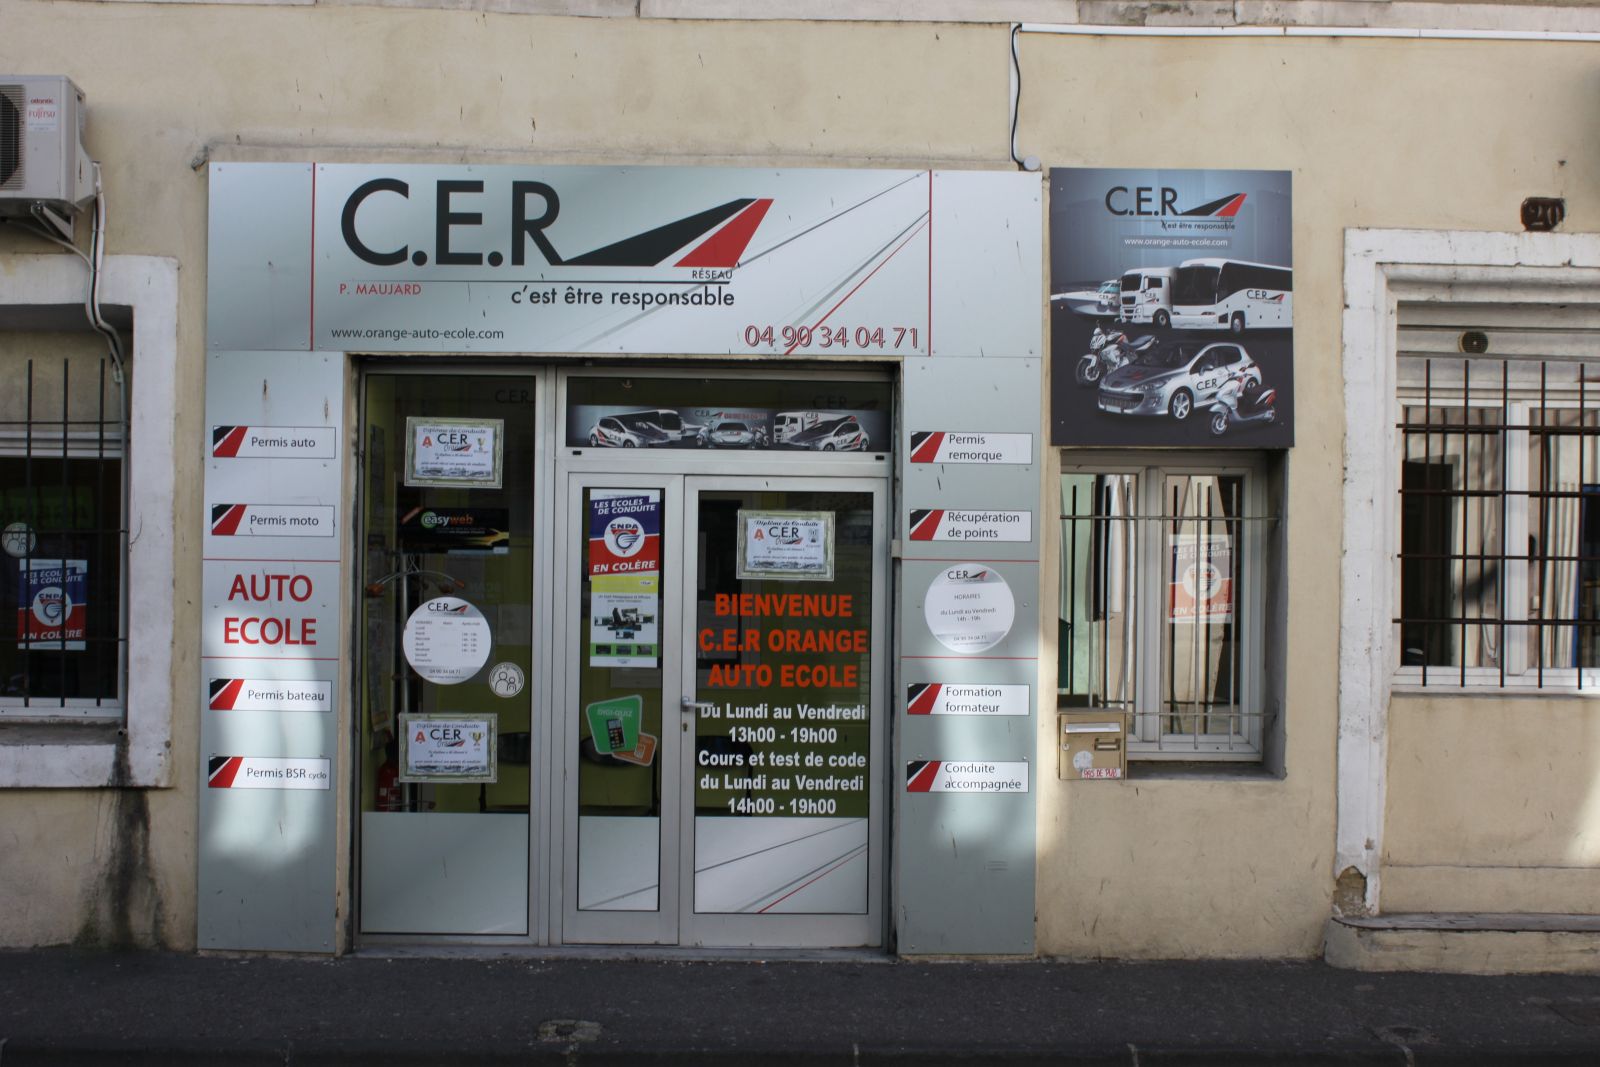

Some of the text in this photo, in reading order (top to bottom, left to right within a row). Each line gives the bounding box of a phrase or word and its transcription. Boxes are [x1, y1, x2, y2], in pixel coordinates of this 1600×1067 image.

[1105, 186, 1178, 216] C.E.R
[341, 177, 565, 266] C.E.R
[1124, 237, 1228, 247] www.orange-auto-ecole.com
[692, 268, 733, 280] RÉSEAU
[339, 284, 422, 295] P. MAUJARD
[511, 285, 735, 310] c'est être responsable
[331, 328, 504, 342] www.orange-auto-ecole.com
[745, 325, 919, 348] 04 90 34 04 71
[251, 436, 316, 448] Permis auto
[949, 434, 986, 445] Permis
[948, 450, 1003, 462] remorque
[594, 498, 643, 509] LES ÉCOLES
[597, 504, 656, 515] DE CONDUITE
[250, 515, 319, 526] Permis moto
[948, 511, 1020, 524] Récupération
[769, 526, 799, 538] C.E.R
[948, 528, 999, 540] de points
[593, 560, 656, 572] EN COLÈRE
[40, 569, 71, 577] ÉCOLS
[228, 575, 313, 602] AUTO
[715, 593, 853, 617] BIENVENUE
[224, 617, 317, 645] ECOLE
[699, 628, 868, 653] C.E.R ORANGE
[708, 664, 858, 688] AUTO ECOLE
[248, 690, 325, 701] Permis bateau
[946, 687, 1002, 697] Formation
[700, 703, 866, 720] Du Lundi au Vendredi
[946, 702, 1000, 713] formateur
[430, 729, 461, 741] C.E.R
[729, 726, 775, 743] 13h00
[791, 727, 837, 744] 19h00
[698, 750, 866, 767] Cours et test de code
[247, 767, 327, 780] Permis BSR cyclo
[945, 763, 995, 774] Conduite
[700, 774, 864, 791] du Lundi au Vendredi
[945, 778, 1021, 791] accompagnée
[728, 798, 775, 814] 14h00
[790, 799, 836, 814] 19h00
